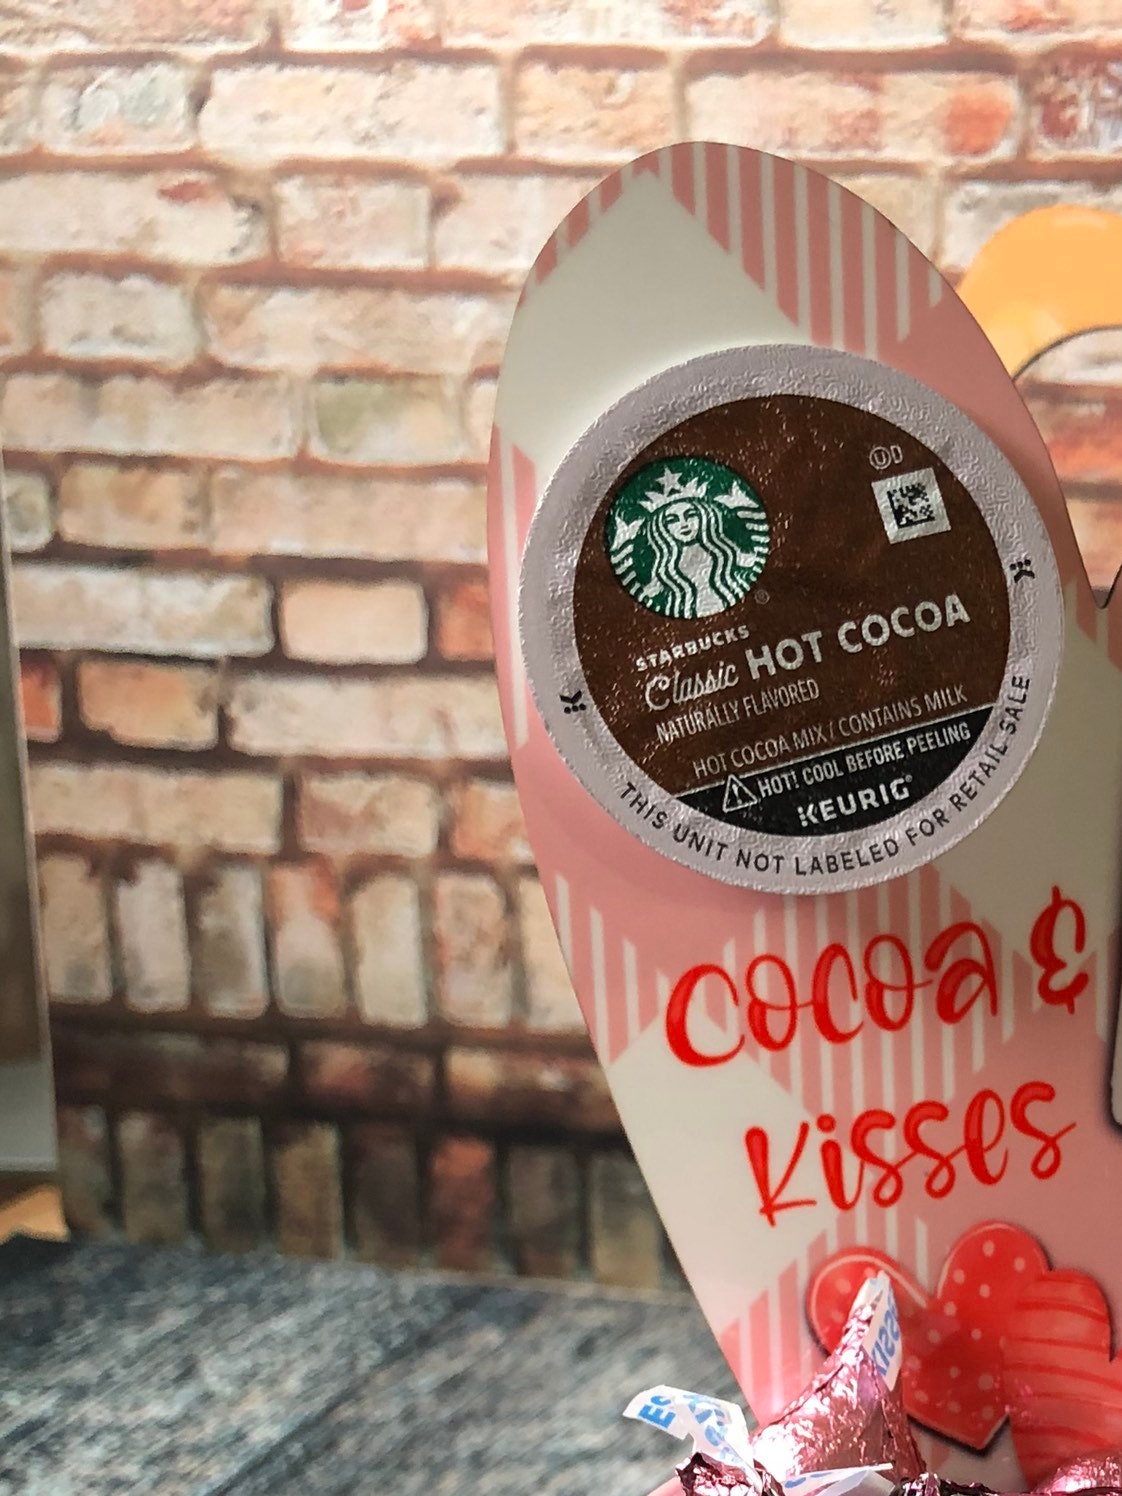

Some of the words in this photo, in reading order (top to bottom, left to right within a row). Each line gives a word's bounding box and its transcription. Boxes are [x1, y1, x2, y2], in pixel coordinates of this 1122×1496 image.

[635, 624, 750, 672] STARBUCKS
[644, 661, 740, 711] Classic
[745, 630, 823, 680] HOT
[837, 592, 971, 653] COCOA
[655, 700, 740, 744] NATURALLY
[743, 678, 820, 718] FLAVORED
[692, 753, 728, 779] HOT
[730, 735, 790, 768] COCOA
[792, 723, 828, 750] MIX
[838, 697, 922, 737] CONTAINS
[924, 684, 968, 712] MILK
[757, 771, 799, 799] HOT!
[802, 758, 845, 786] COOL
[846, 741, 905, 774] BEFORE
[906, 721, 971, 755] PEELING
[620, 781, 669, 830] THIS
[672, 823, 729, 862] UNIT
[736, 849, 785, 875] NOT
[795, 837, 900, 877] LABELED
[905, 808, 950, 846] FOR
[949, 744, 1008, 812] RETAIL
[999, 675, 1031, 735] SALE
[1029, 885, 1089, 1015] &
[745, 1080, 1077, 1228] Kisses
